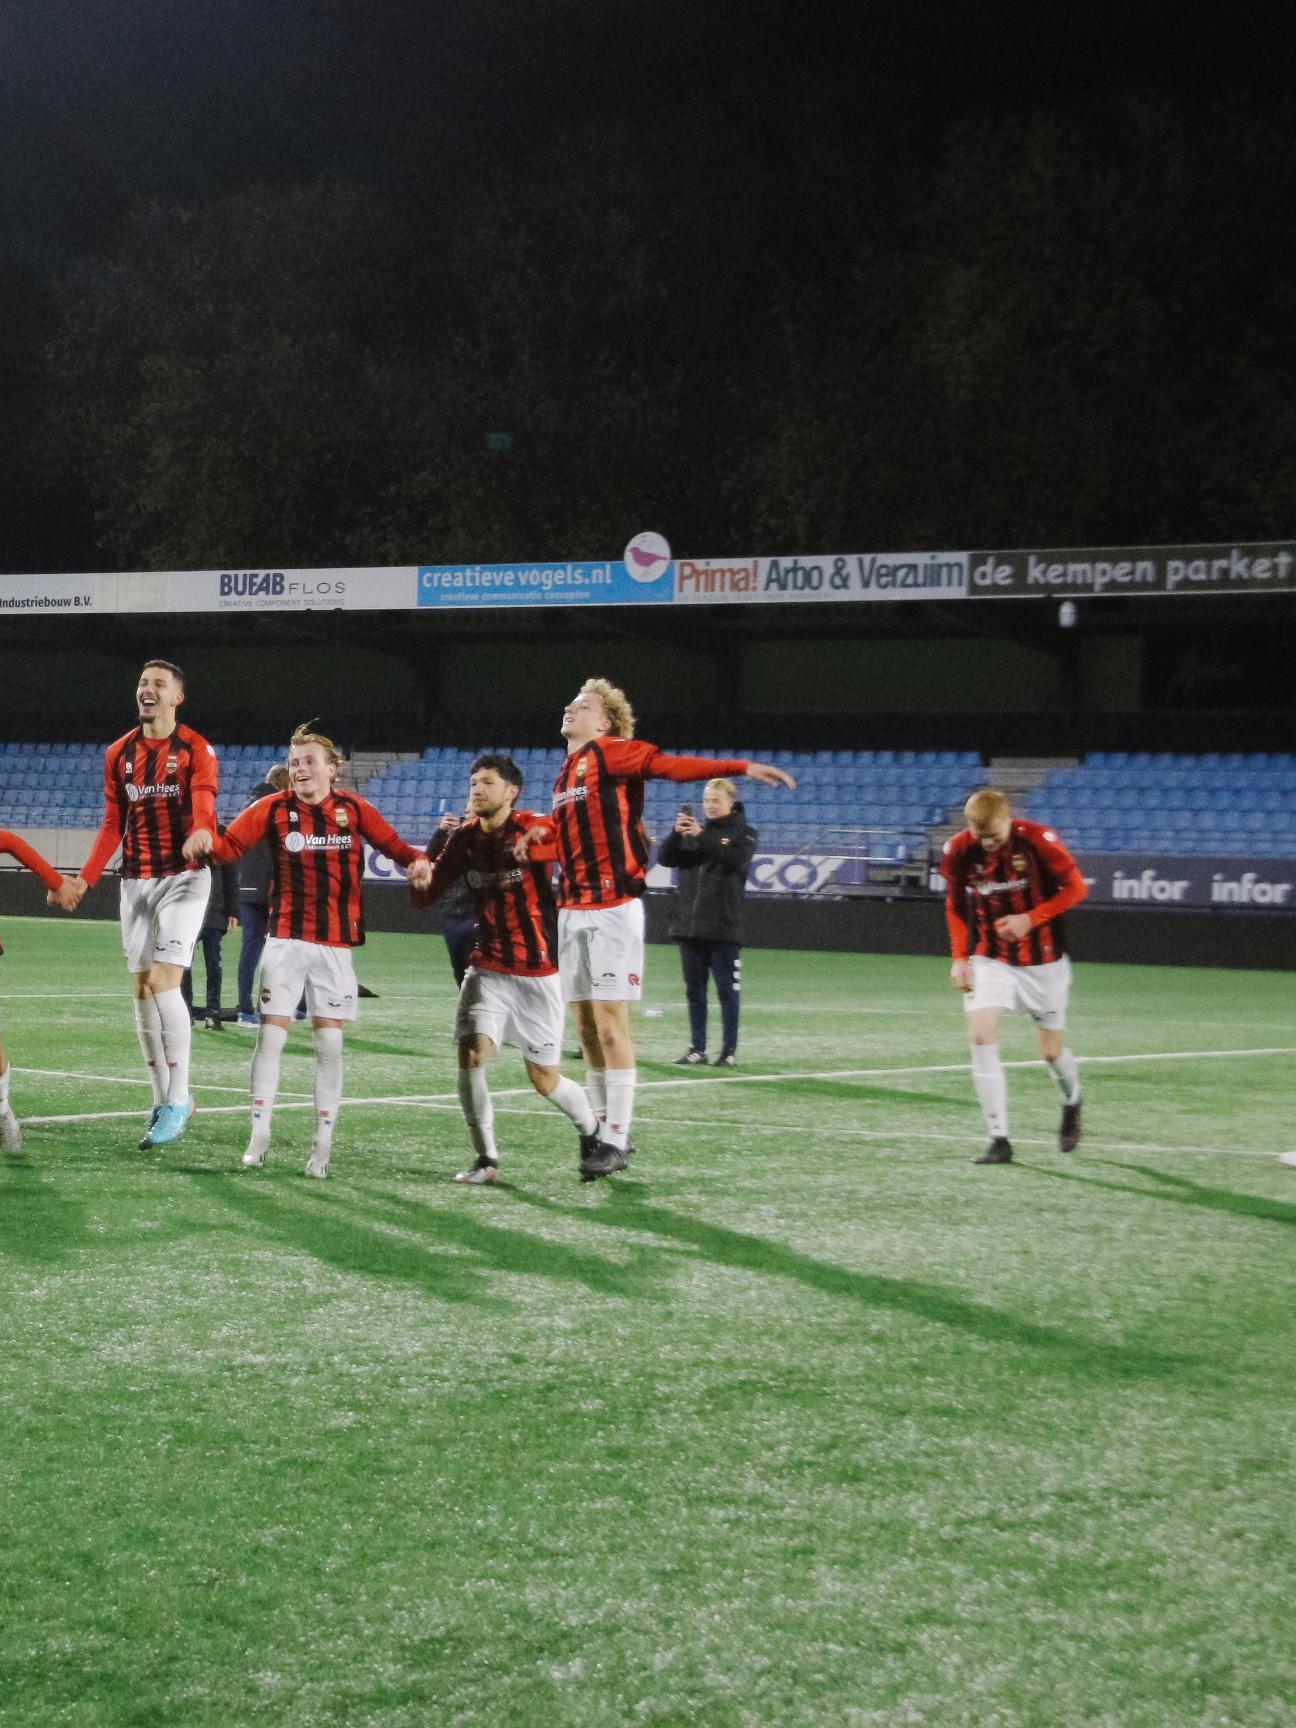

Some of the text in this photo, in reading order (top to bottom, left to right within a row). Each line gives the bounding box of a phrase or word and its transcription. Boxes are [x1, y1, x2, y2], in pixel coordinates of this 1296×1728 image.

[219, 573, 346, 596] BUFAB FLOS
[679, 554, 963, 593] Prima! Arbo & Verzuim
[973, 549, 1294, 592] de kempen parket
[0, 595, 92, 609] Industriebouw B.V.
[1113, 869, 1191, 900] infor
[1211, 872, 1293, 903] infor
